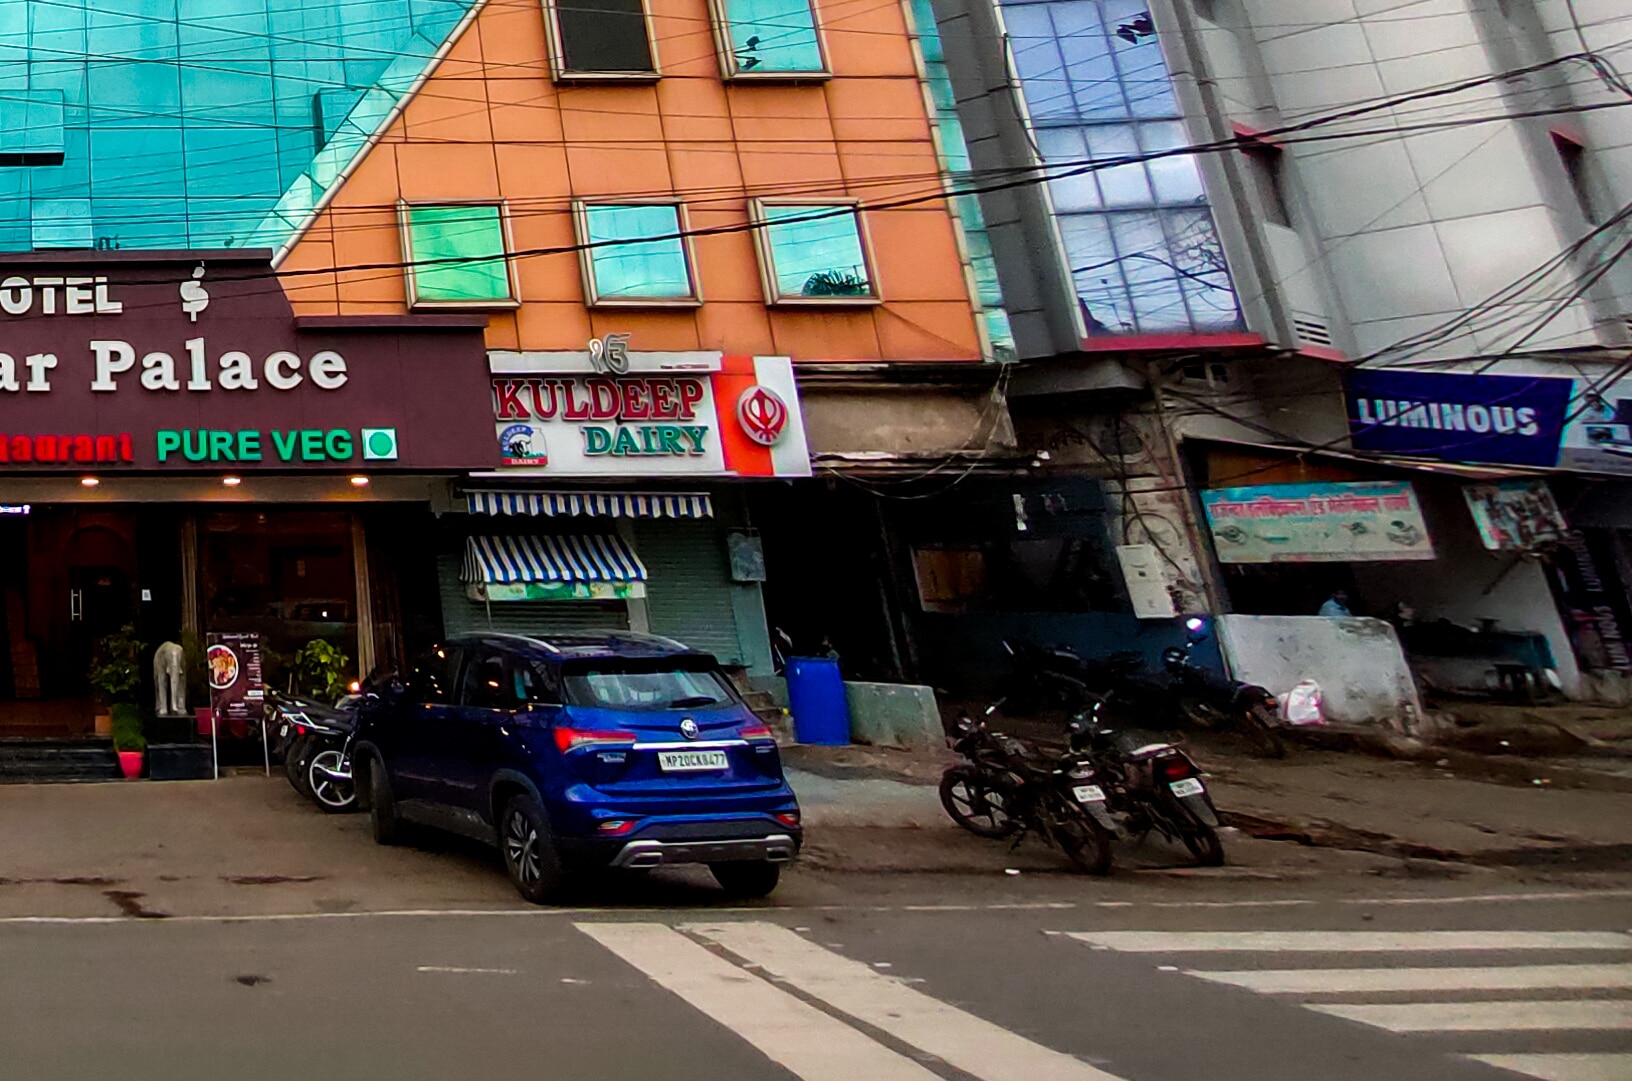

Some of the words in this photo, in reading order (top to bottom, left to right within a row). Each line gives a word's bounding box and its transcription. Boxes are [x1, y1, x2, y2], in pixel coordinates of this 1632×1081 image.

[90, 337, 349, 391] Palace
[492, 378, 704, 420] KULDEEP
[1357, 398, 1541, 436] LUMINOUS
[156, 428, 263, 462] PURE
[272, 428, 354, 462] VEG
[581, 426, 709, 455] DAIRY
